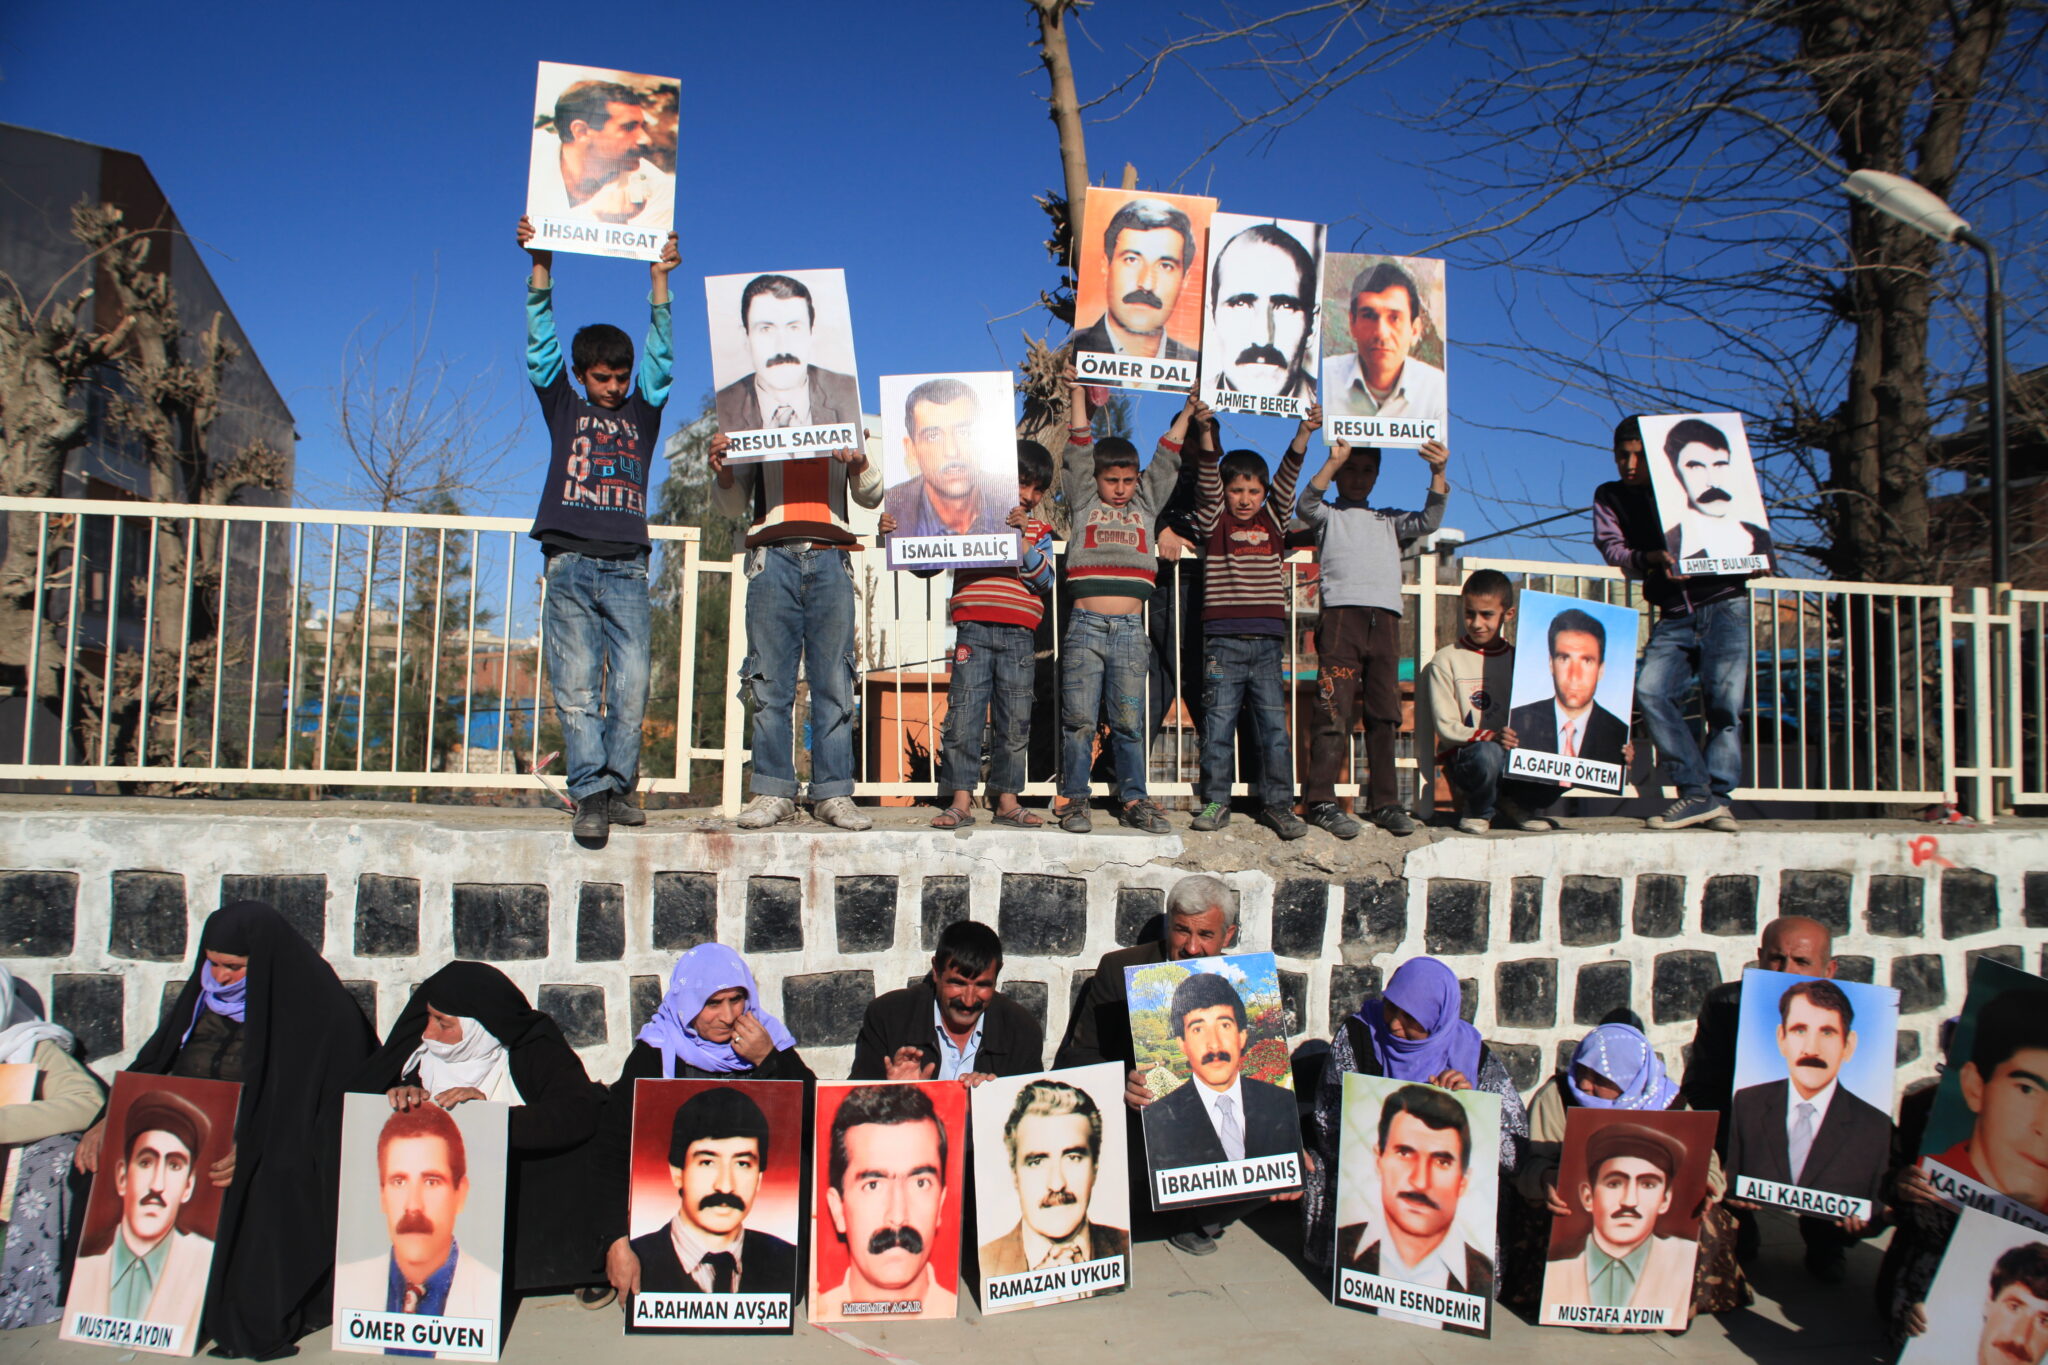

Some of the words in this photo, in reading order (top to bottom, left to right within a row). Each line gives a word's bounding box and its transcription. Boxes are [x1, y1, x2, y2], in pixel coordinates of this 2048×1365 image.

[543, 218, 599, 242] İHSAN
[605, 229, 658, 249] IRGAT
[1081, 354, 1143, 378] ÖMER
[1150, 364, 1191, 382] DAL
[1216, 391, 1257, 409] AHMET
[1260, 396, 1299, 413] BEREK
[730, 434, 787, 452] RESUL
[791, 429, 853, 447] SAKAR
[1334, 421, 1384, 437] RESUL
[902, 538, 957, 559] İSMAİL
[962, 536, 1009, 561] BALİÇ
[1096, 530, 1138, 545] CHILD
[1686, 559, 1719, 572] AHMET
[1513, 755, 1571, 777] A.GAFUR
[1575, 761, 1617, 785] ÖKTEM
[1161, 1164, 1238, 1195] İBRAHİM
[1242, 1160, 1296, 1184] DANIŞ
[1928, 1169, 1996, 1214] KASIM
[989, 1271, 1066, 1300] RAMAZAN
[1071, 1262, 1120, 1286] UYKUR
[637, 1300, 728, 1319] A.RAHMAN
[734, 1300, 788, 1325] AVŞAR
[843, 1302, 890, 1315] MEHMET
[891, 1301, 922, 1313] ACAR
[1344, 1277, 1395, 1304] OSMAN
[1400, 1289, 1481, 1323] ESENDEMİR
[1558, 1305, 1619, 1323] MUSTAFA
[1624, 1309, 1664, 1325] AYDIN
[76, 1315, 131, 1342] MUSTAFA
[133, 1324, 173, 1348] AYDIN
[350, 1313, 405, 1342] ÖMER
[412, 1319, 484, 1348] GÜVEN
